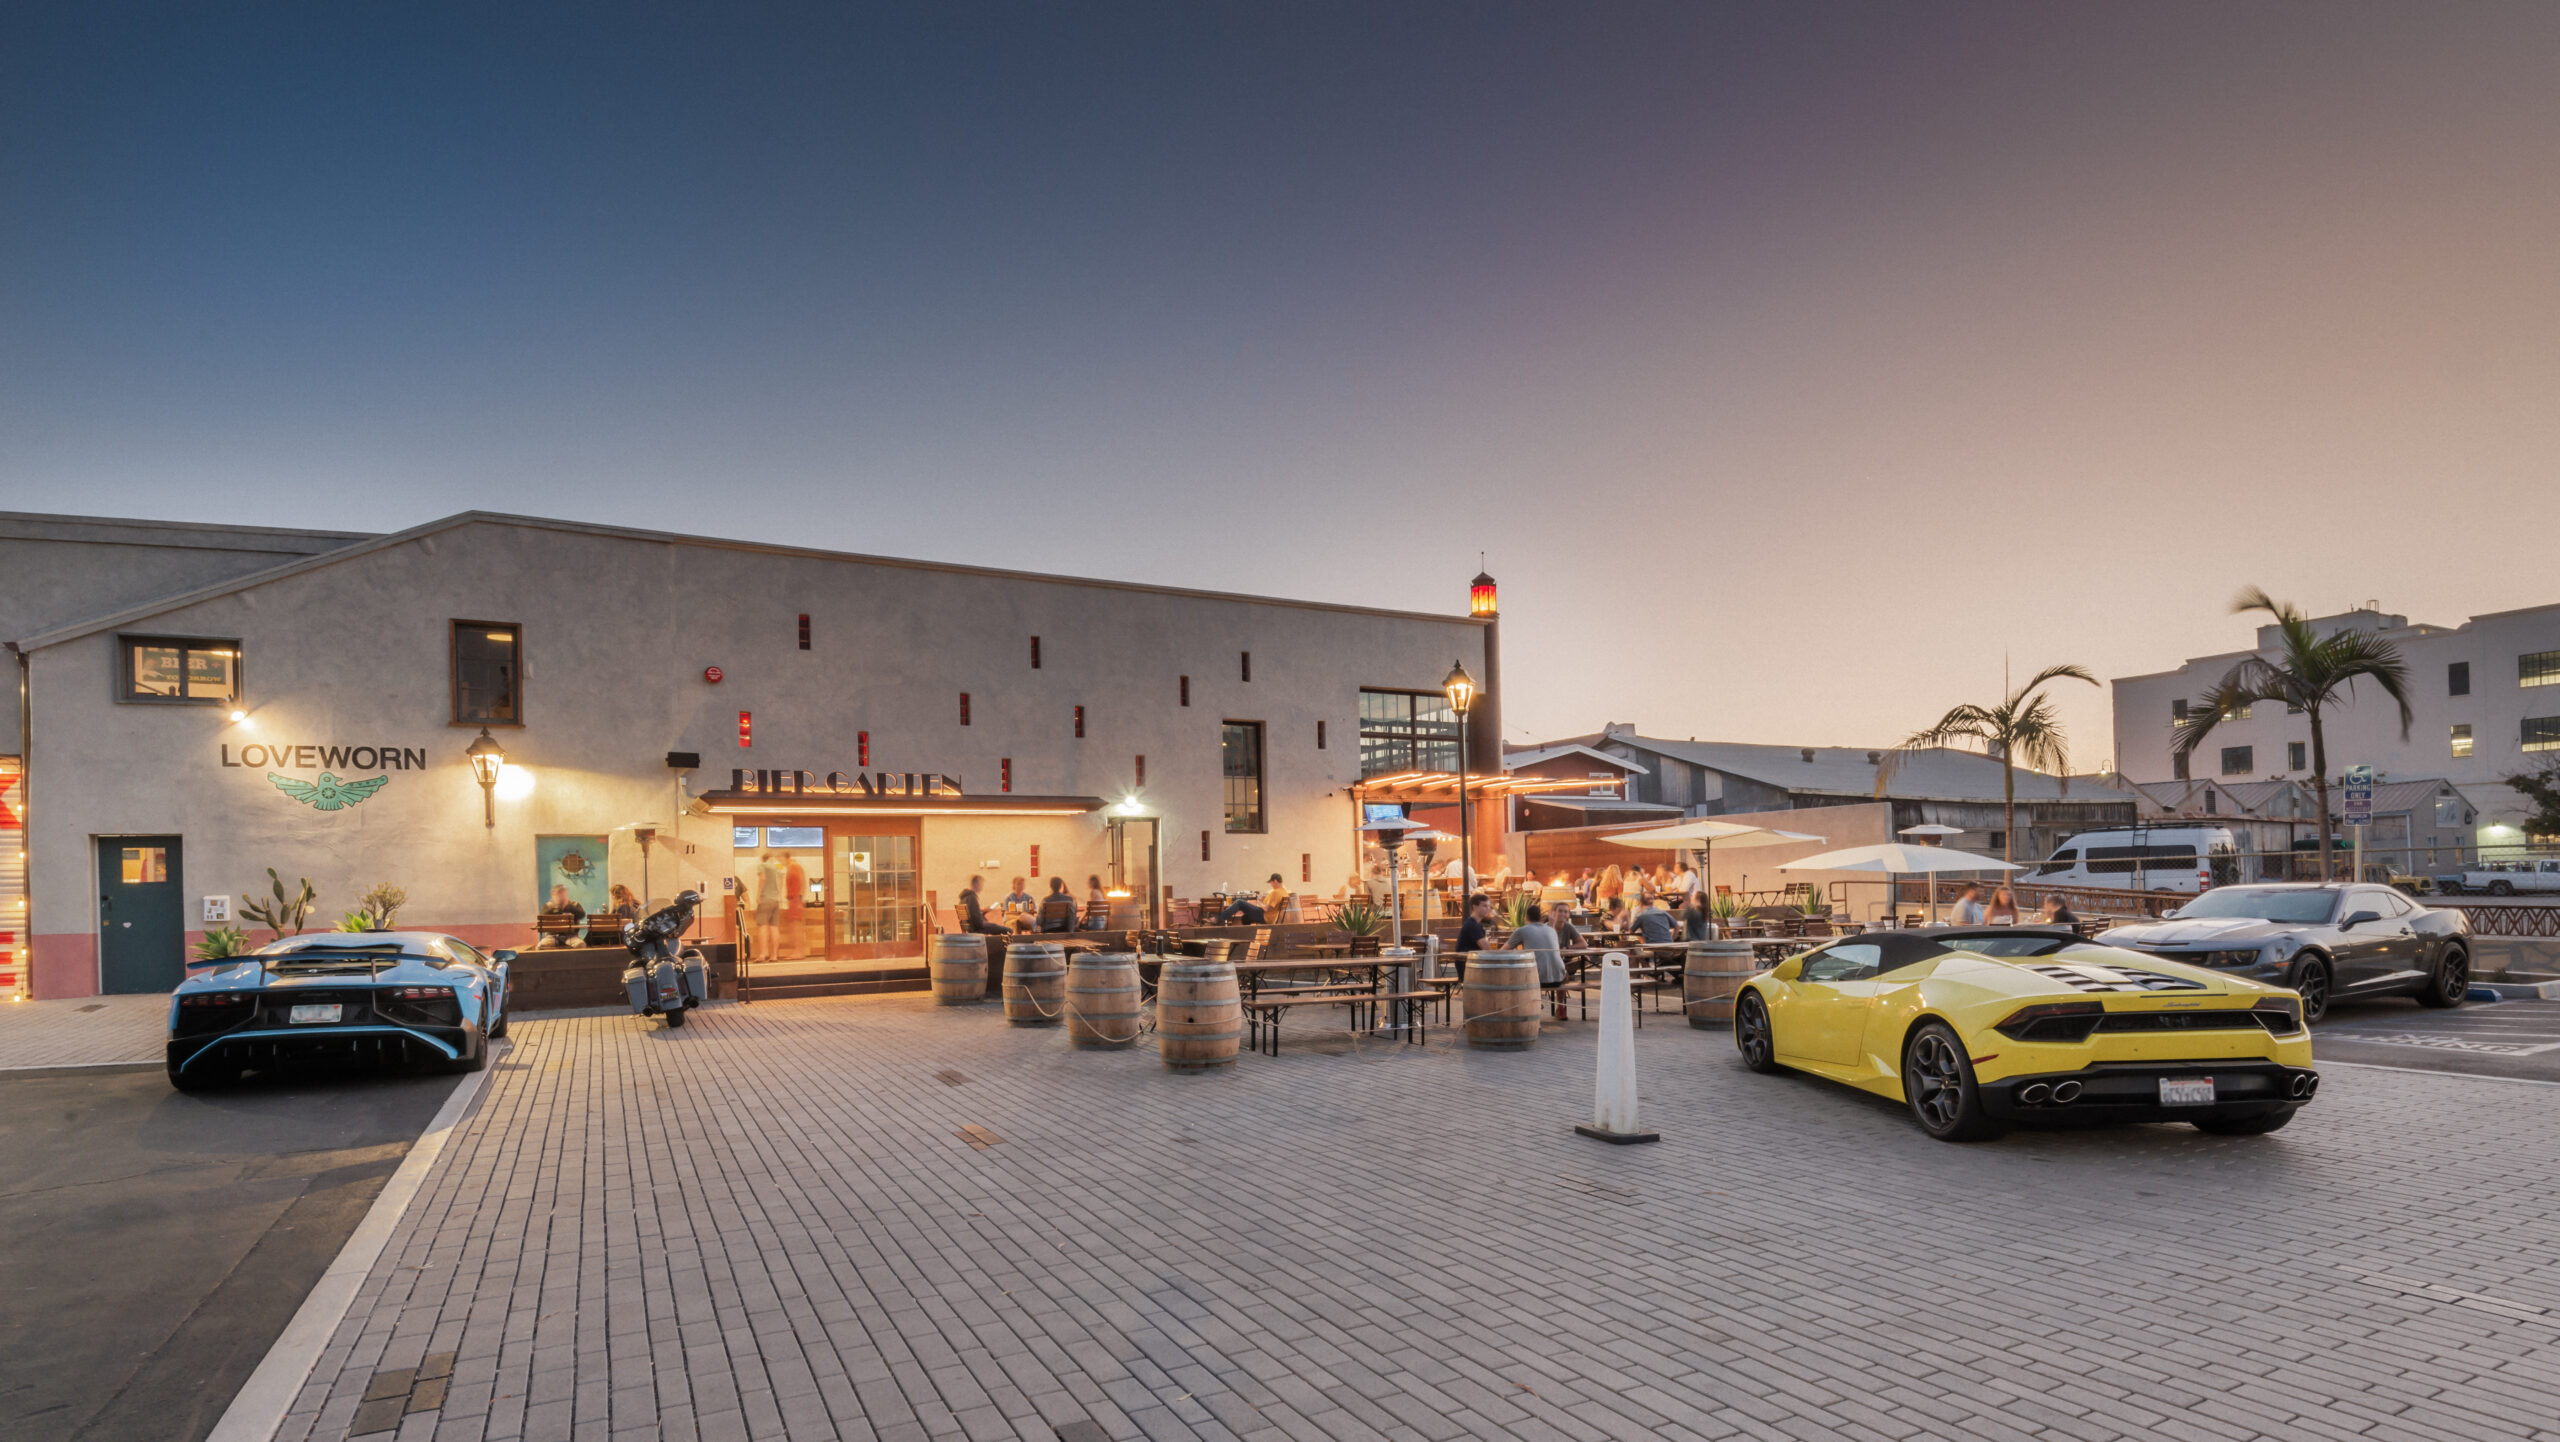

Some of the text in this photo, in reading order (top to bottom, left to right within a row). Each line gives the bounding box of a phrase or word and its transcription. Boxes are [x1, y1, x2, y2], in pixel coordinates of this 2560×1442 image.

[166, 674, 221, 682] TOORROW
[221, 743, 426, 770] LOVEWORN
[732, 769, 963, 796] BIER GARTEN
[686, 844, 695, 854] 11
